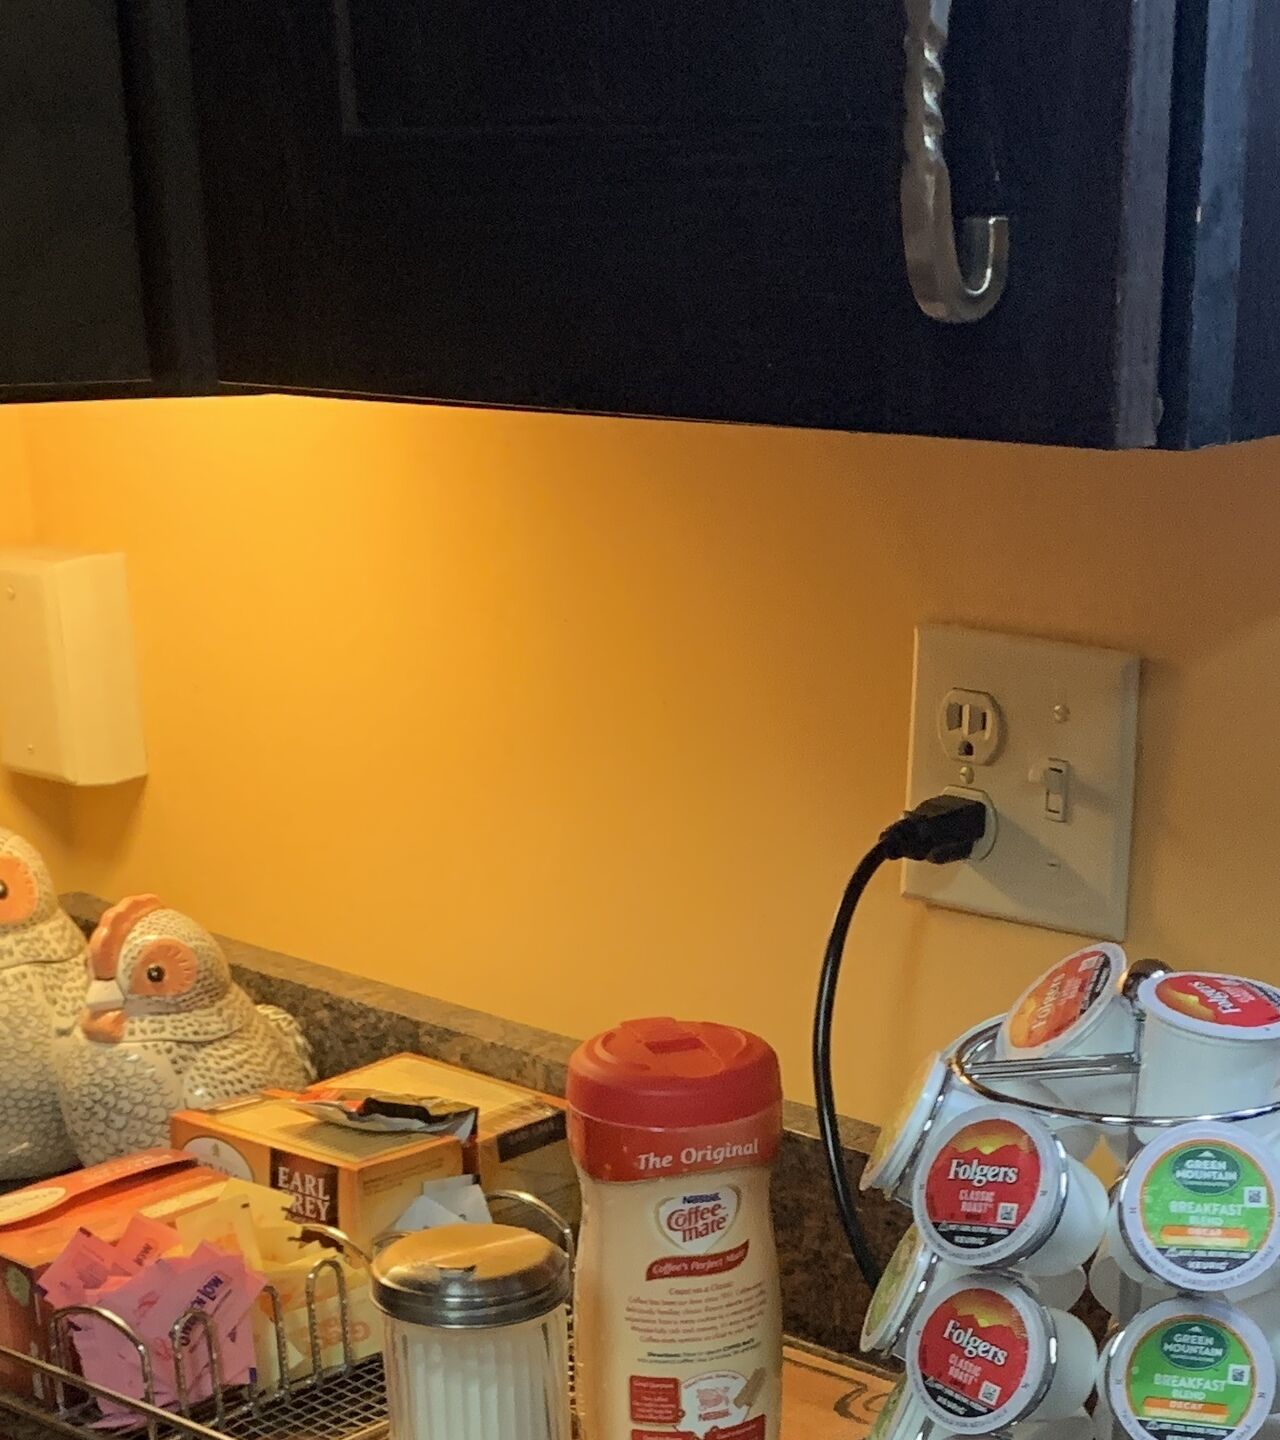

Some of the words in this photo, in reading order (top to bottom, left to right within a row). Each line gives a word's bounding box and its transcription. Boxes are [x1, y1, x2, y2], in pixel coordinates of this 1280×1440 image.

[638, 1152, 673, 1170] The
[680, 1138, 759, 1164] Original
[947, 1158, 1018, 1186] Folgers
[1184, 1159, 1227, 1170] GREEN
[278, 1166, 330, 1200] EARL
[1175, 1169, 1238, 1181] MOUNTAIN
[959, 1190, 995, 1202] CLASSIC
[290, 1195, 331, 1221] REY
[1168, 1200, 1245, 1216] BREAKFAST
[942, 1319, 1008, 1366] Folgers
[1173, 1333, 1214, 1345] GREEN
[1163, 1343, 1223, 1356] MOUNTAIN
[948, 1353, 982, 1376] CLASSIC
[1154, 1373, 1227, 1392] BREAKFAST
[1172, 1389, 1206, 1400] BLEND
